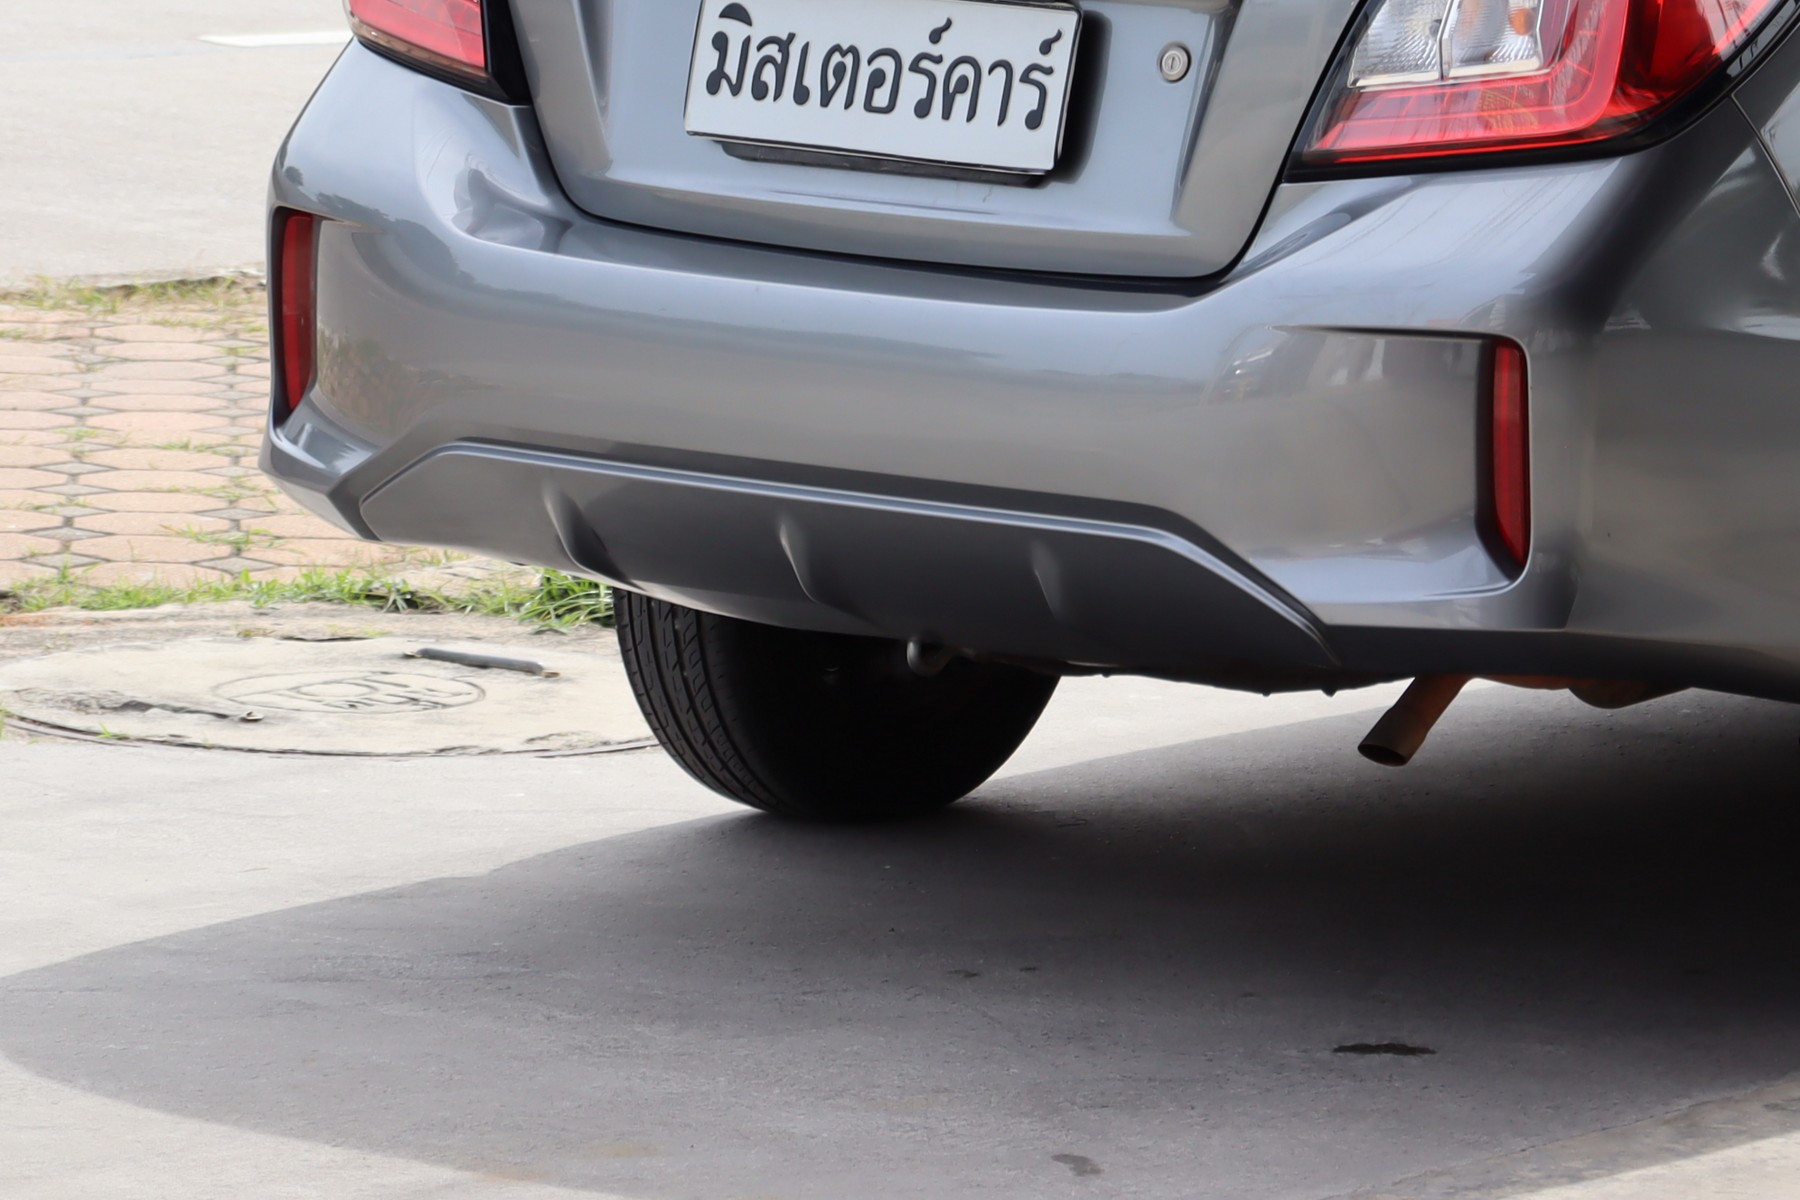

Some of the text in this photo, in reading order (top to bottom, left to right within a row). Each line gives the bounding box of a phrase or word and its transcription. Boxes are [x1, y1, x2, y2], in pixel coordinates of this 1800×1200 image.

[705, 2, 1063, 131] มิสเตอร์คาร์
